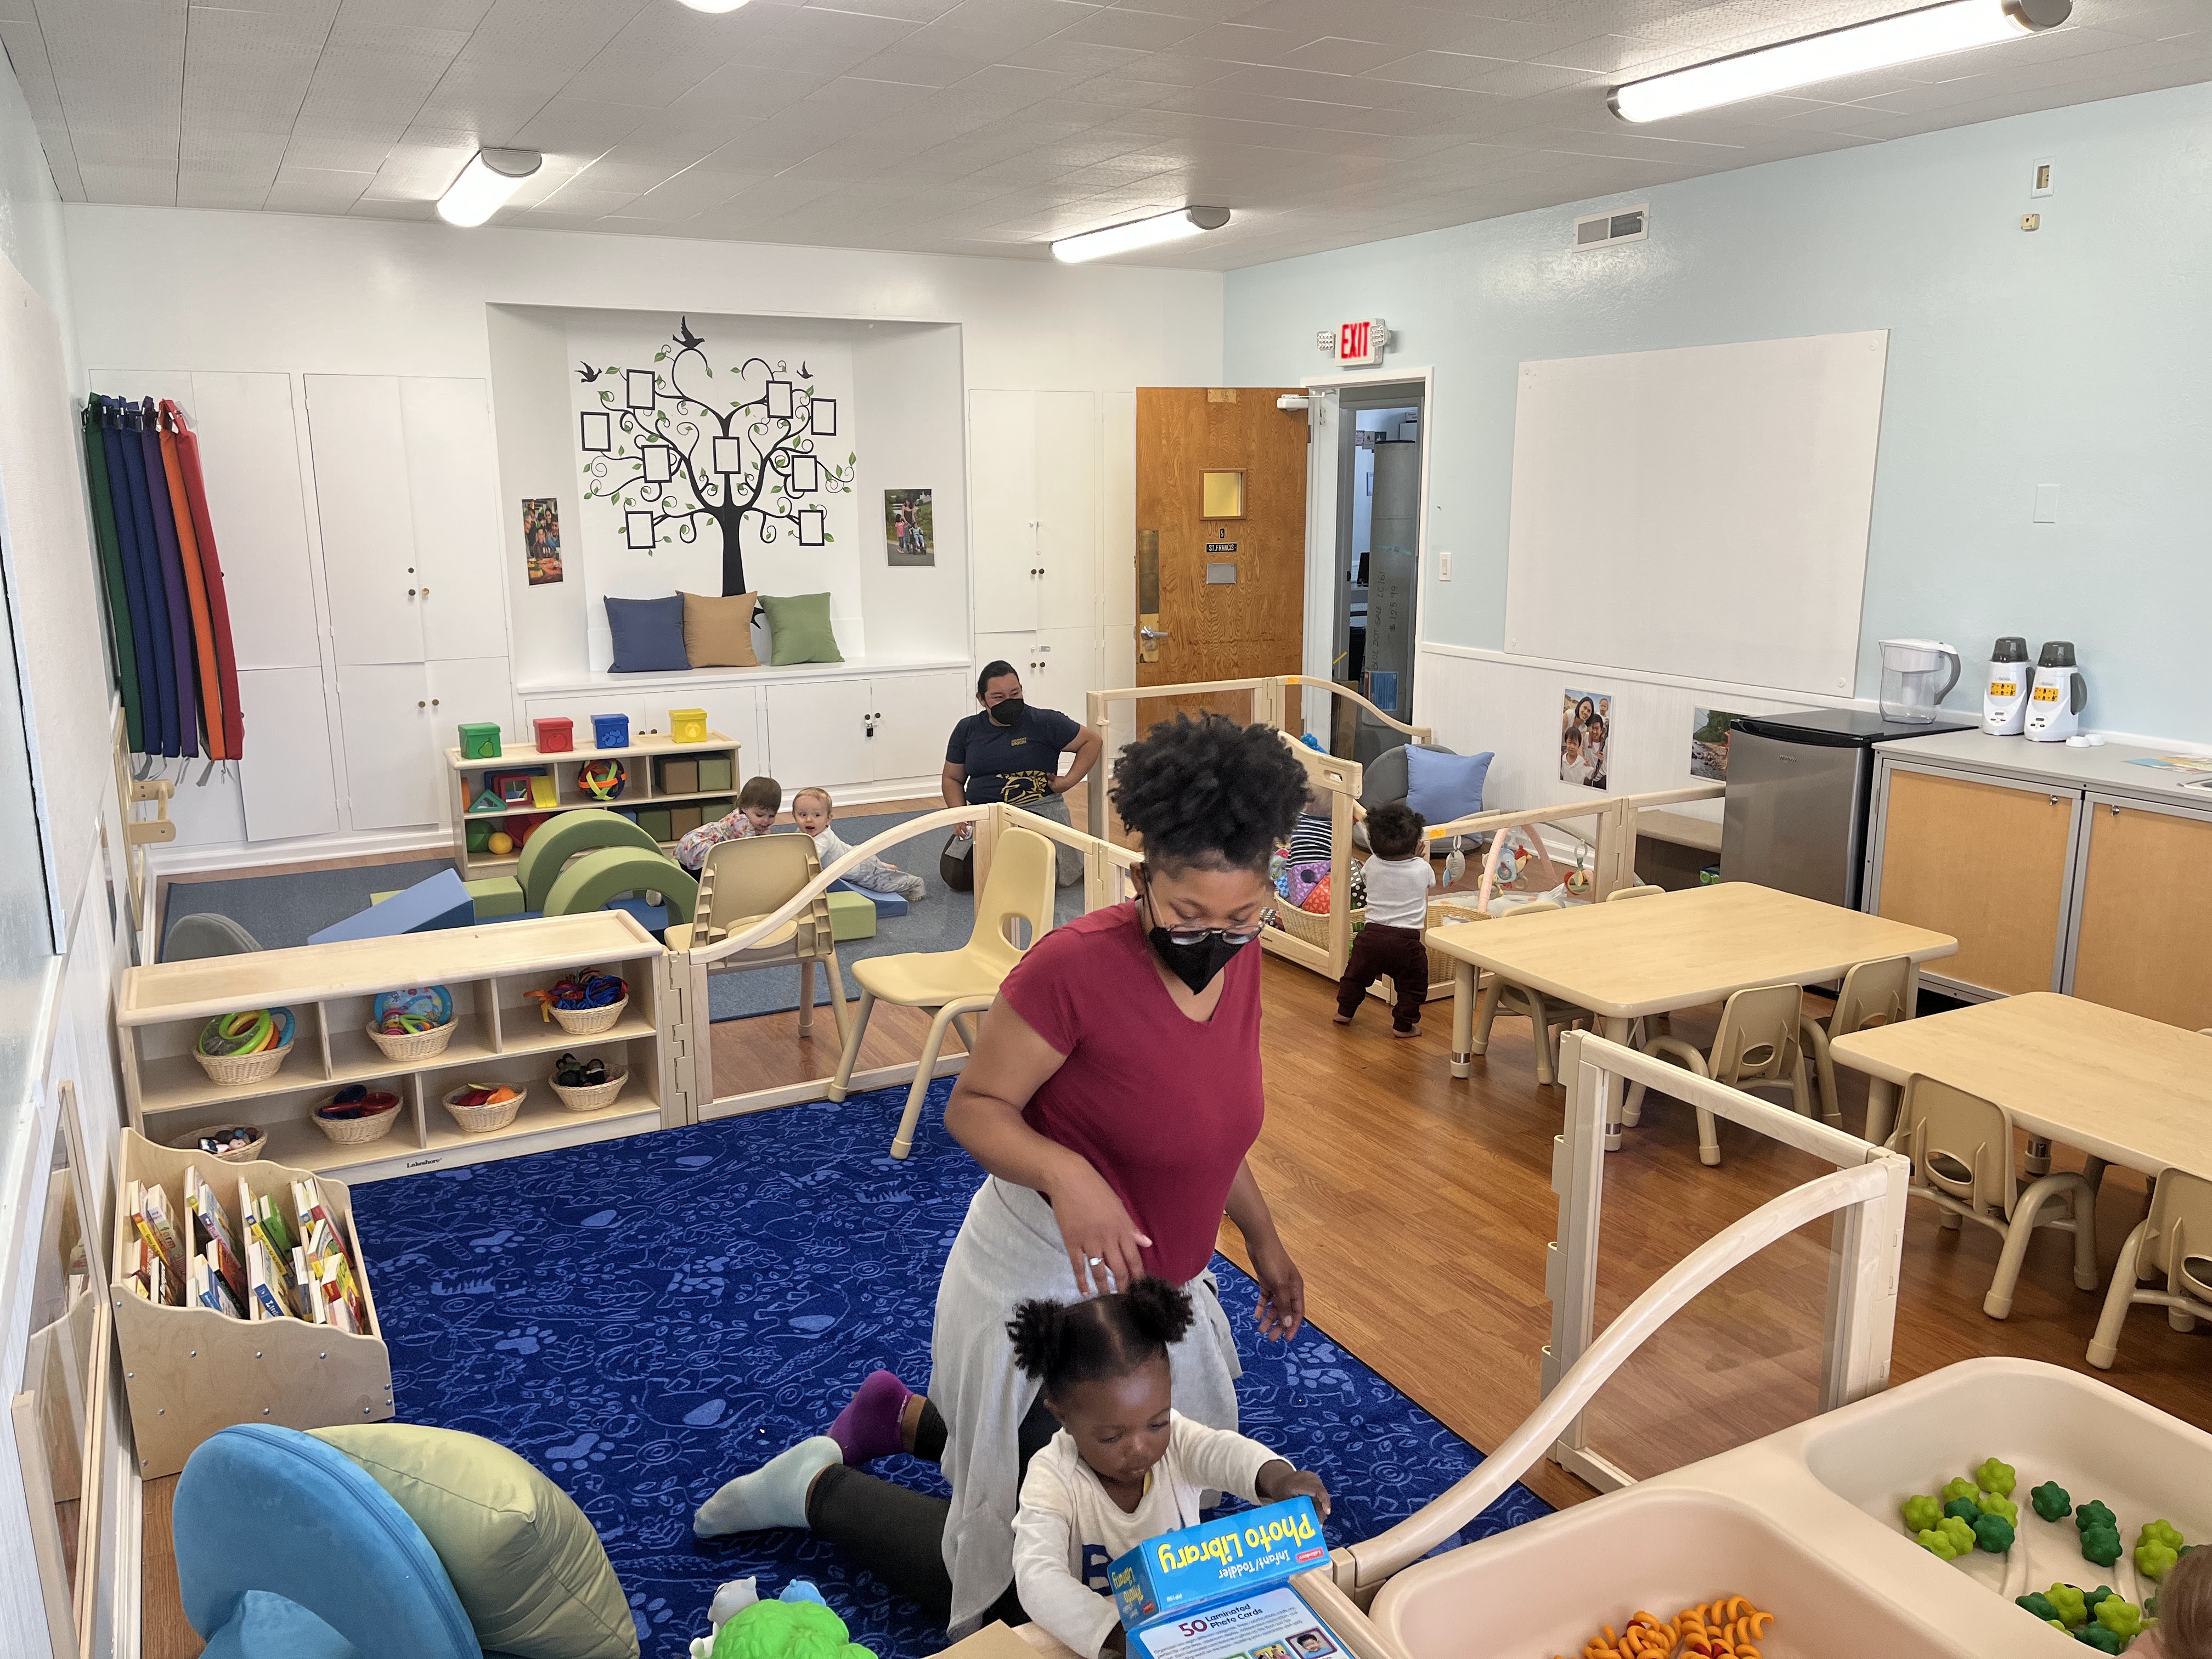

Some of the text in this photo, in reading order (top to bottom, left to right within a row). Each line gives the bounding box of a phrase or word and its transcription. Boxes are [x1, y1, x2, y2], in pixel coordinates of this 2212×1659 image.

[1341, 321, 1370, 359] EXIT
[407, 1159, 440, 1168] Lakeshore
[160, 1224, 177, 1249] farm
[1157, 1512, 1315, 1574] Photo Library
[1217, 1549, 1290, 1580] Infant/Toddler
[1204, 1603, 1252, 1622] Laminated
[1209, 1607, 1263, 1629] Photo Cards
[1178, 1619, 1208, 1638] 50
